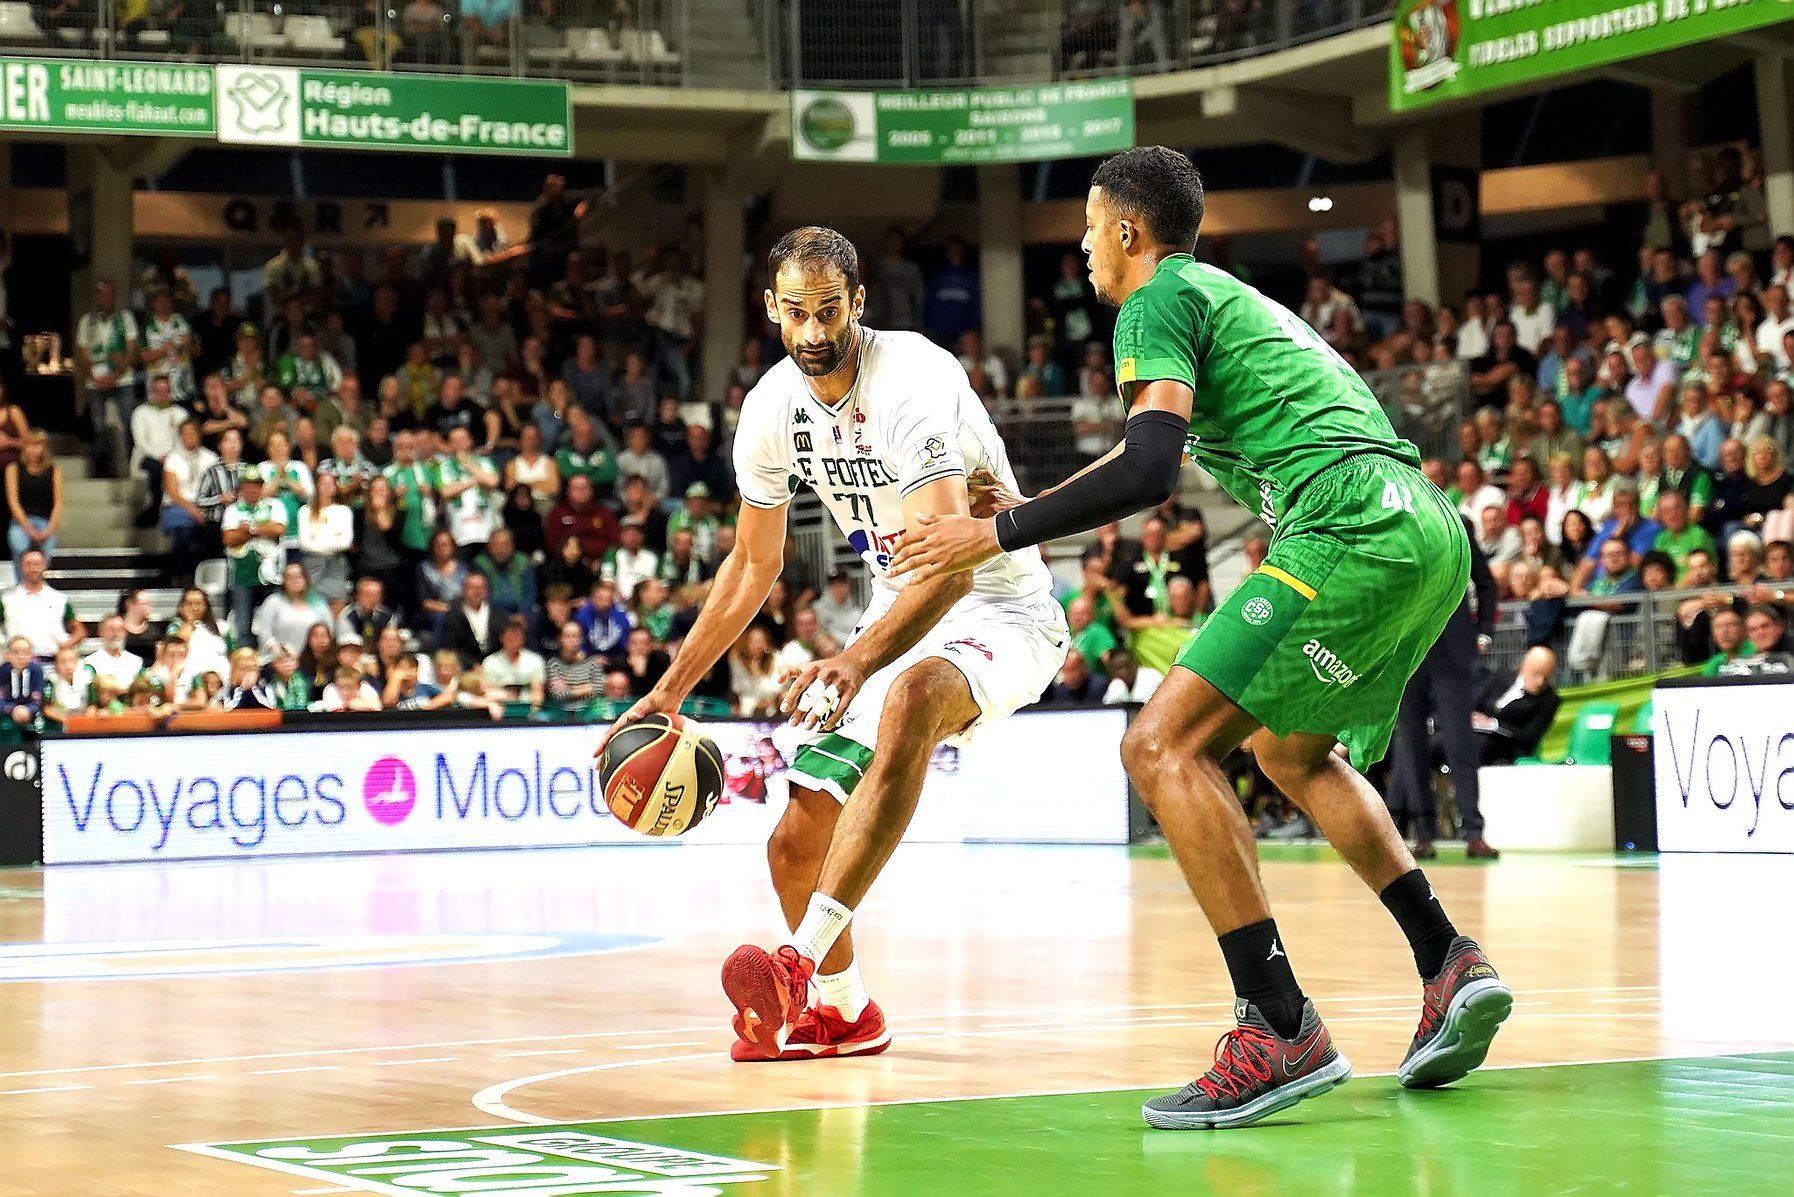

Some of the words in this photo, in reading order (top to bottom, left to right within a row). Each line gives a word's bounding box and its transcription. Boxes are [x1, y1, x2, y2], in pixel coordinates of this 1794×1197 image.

[1543, 1, 1658, 51] SUPPORTERS
[60, 64, 212, 96] SAINT-LEONARD
[303, 79, 391, 109] Région
[303, 107, 567, 147] Hauts-de-France
[792, 457, 818, 486] E
[1244, 600, 1271, 620] CSP
[1302, 638, 1360, 689] amazon
[57, 761, 347, 852] Voyages
[516, 1137, 731, 1170] GROUPE
